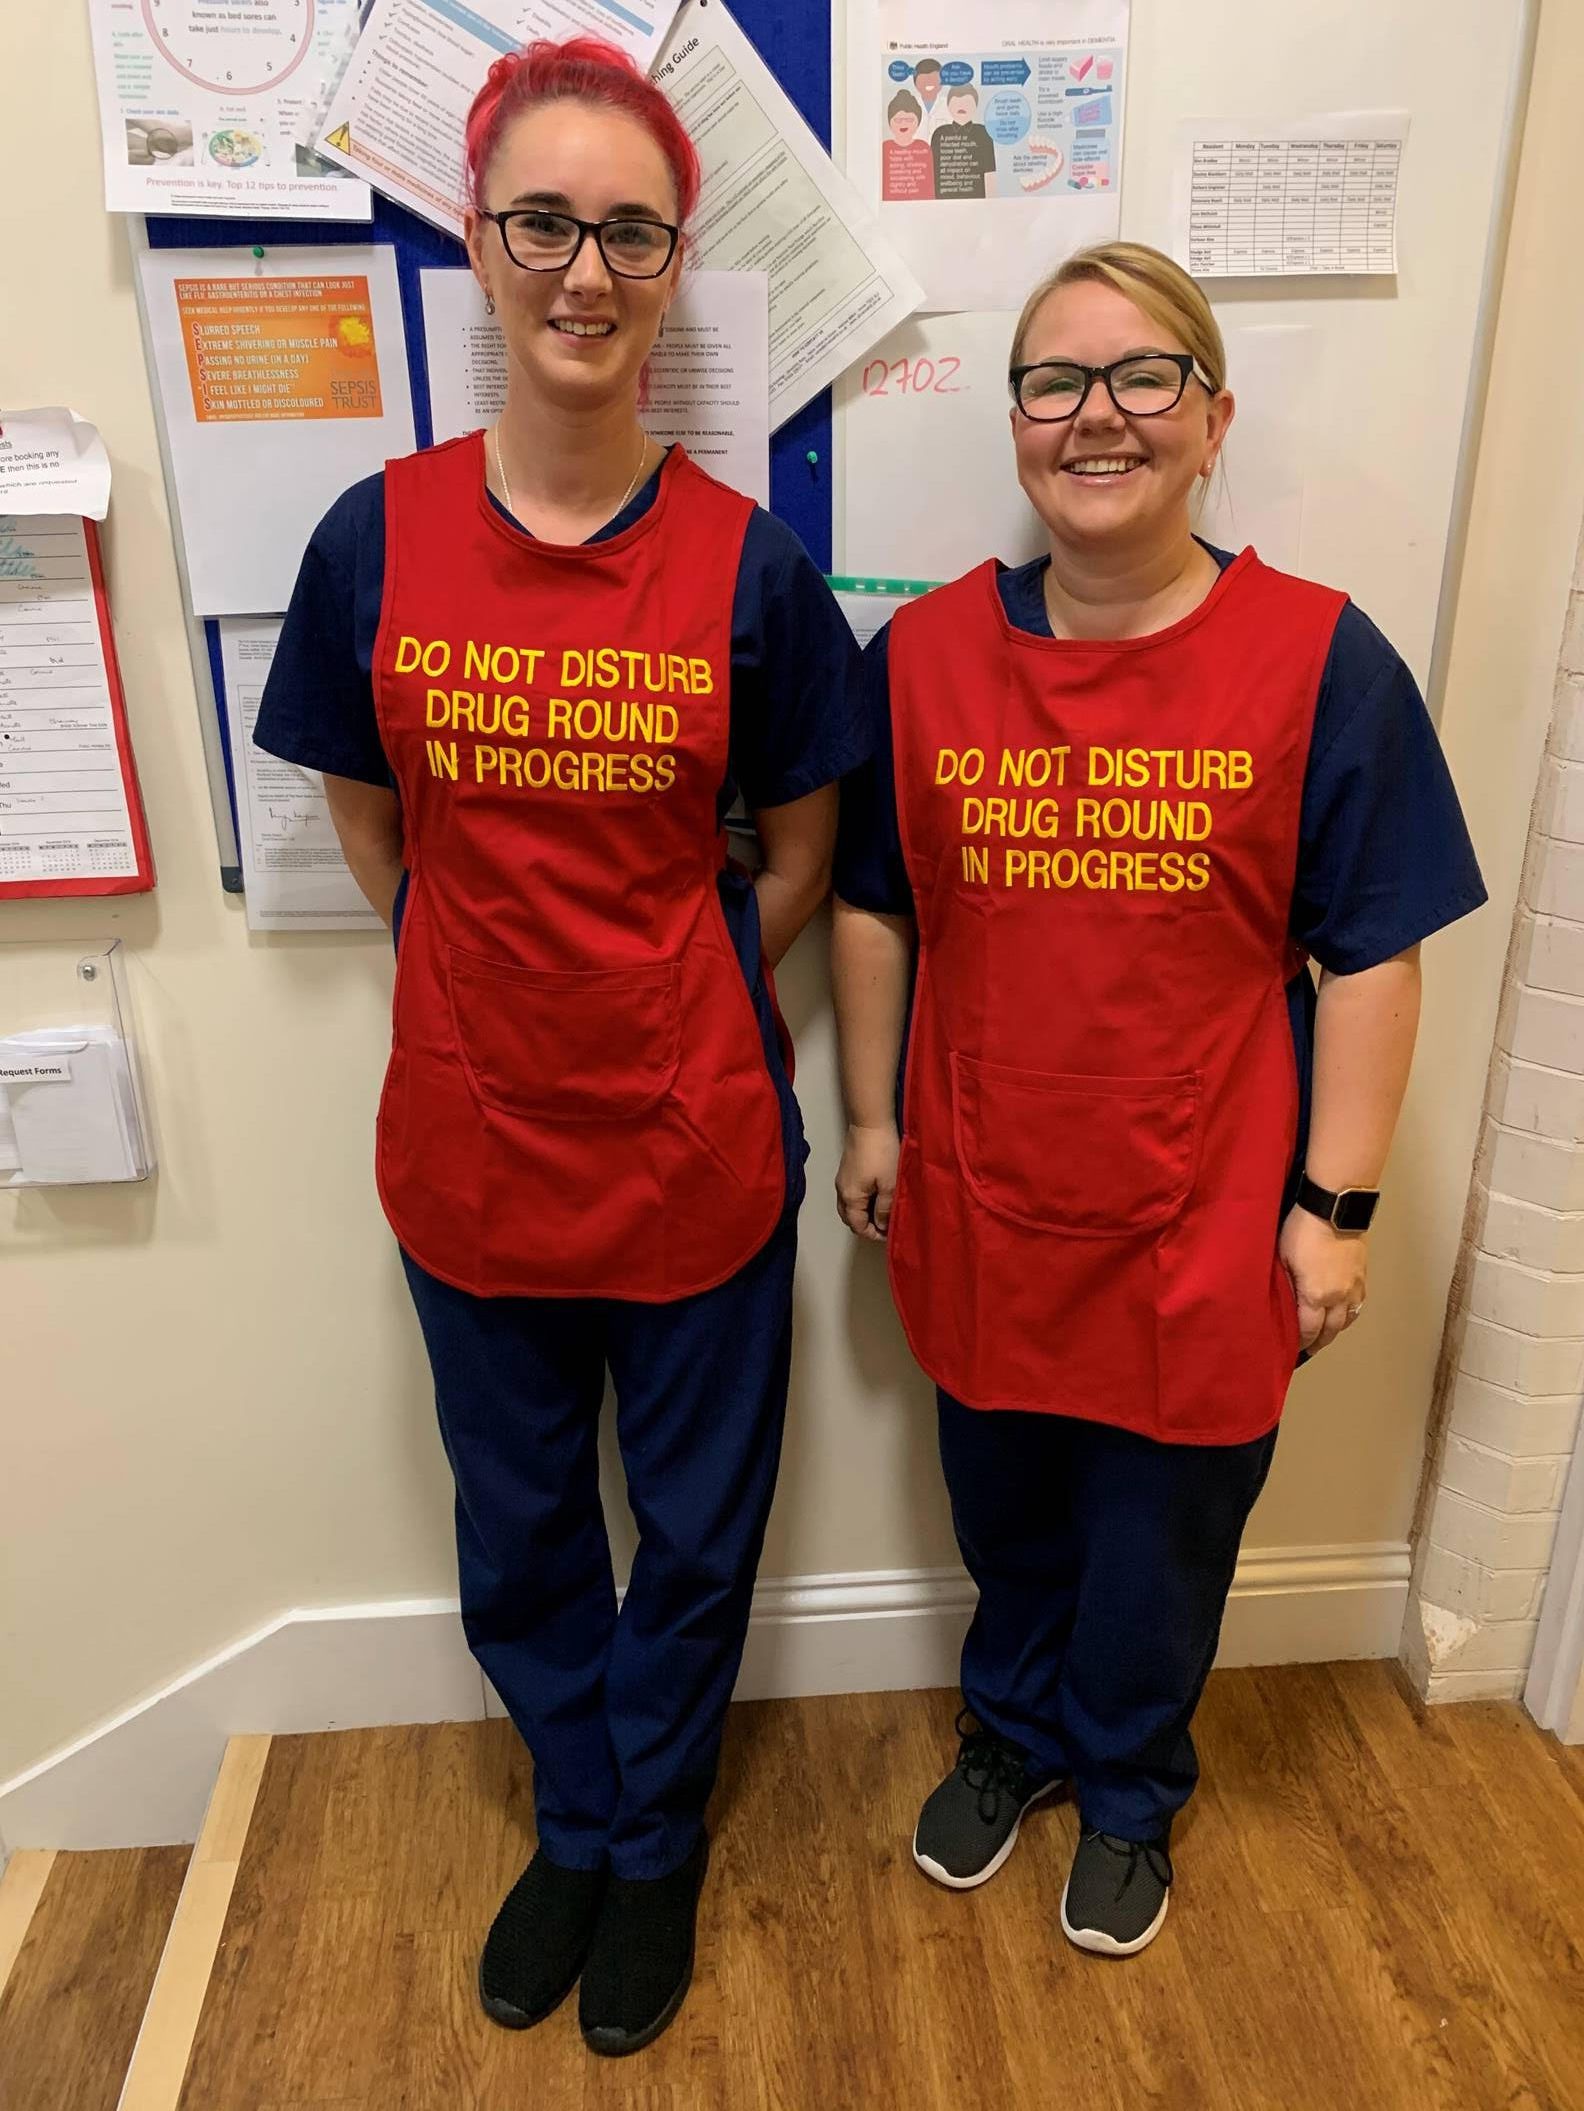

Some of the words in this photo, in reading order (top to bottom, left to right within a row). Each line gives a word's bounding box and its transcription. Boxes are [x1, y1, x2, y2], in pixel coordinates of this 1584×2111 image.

[192, 11, 216, 19] known
[227, 11, 242, 20] bed
[162, 28, 169, 37] 8
[188, 25, 204, 33] take
[205, 26, 219, 34] just
[289, 34, 296, 43] 4
[672, 37, 700, 64] Guide
[226, 71, 232, 80] 6
[146, 177, 196, 187] Prevention
[197, 179, 205, 187] is
[227, 180, 244, 191] Top
[246, 180, 256, 189] 12
[257, 181, 274, 191] tips
[276, 182, 287, 190] to
[288, 182, 338, 192] prevention
[192, 322, 230, 336] SLURRED
[231, 325, 260, 335] SPEECH
[195, 338, 233, 351] EXTREME
[235, 339, 277, 349] SHIVERING
[278, 339, 286, 348] OR
[288, 338, 319, 349] MUSCLE
[320, 338, 338, 348] PAIN
[197, 353, 233, 366] PASSING
[234, 355, 244, 365] NO
[246, 355, 270, 365] URINE
[199, 369, 233, 381] SEVERE
[233, 369, 299, 380] BREATHLESSNESS
[210, 385, 229, 395] FEEL
[230, 385, 246, 395] LIKE
[253, 384, 276, 394] MIGHT
[330, 380, 377, 395] SEPSIS
[204, 398, 225, 411] SKIN
[226, 399, 261, 409] MOTTLED
[262, 399, 272, 409] OR
[274, 397, 324, 409] DISCOLOURED
[334, 396, 377, 409] TRUST
[14, 451, 44, 462] booking
[46, 450, 59, 459] any
[7, 465, 25, 473] then
[394, 636, 451, 678] DO
[463, 640, 546, 685] NOT
[560, 648, 715, 695] DISTURB
[425, 689, 530, 737] DRUG
[547, 698, 680, 744] ROUND
[425, 740, 459, 781] IN
[474, 744, 677, 793] PROGRESS
[935, 747, 985, 786] DO
[998, 745, 1072, 788] NOT
[1087, 746, 1254, 790] DISTURB
[961, 797, 1060, 838] DRUG
[1075, 797, 1213, 842] ROUND
[961, 846, 989, 885] IN
[1004, 848, 1211, 893] PROGRESS
[34, 1067, 62, 1075] Forms
